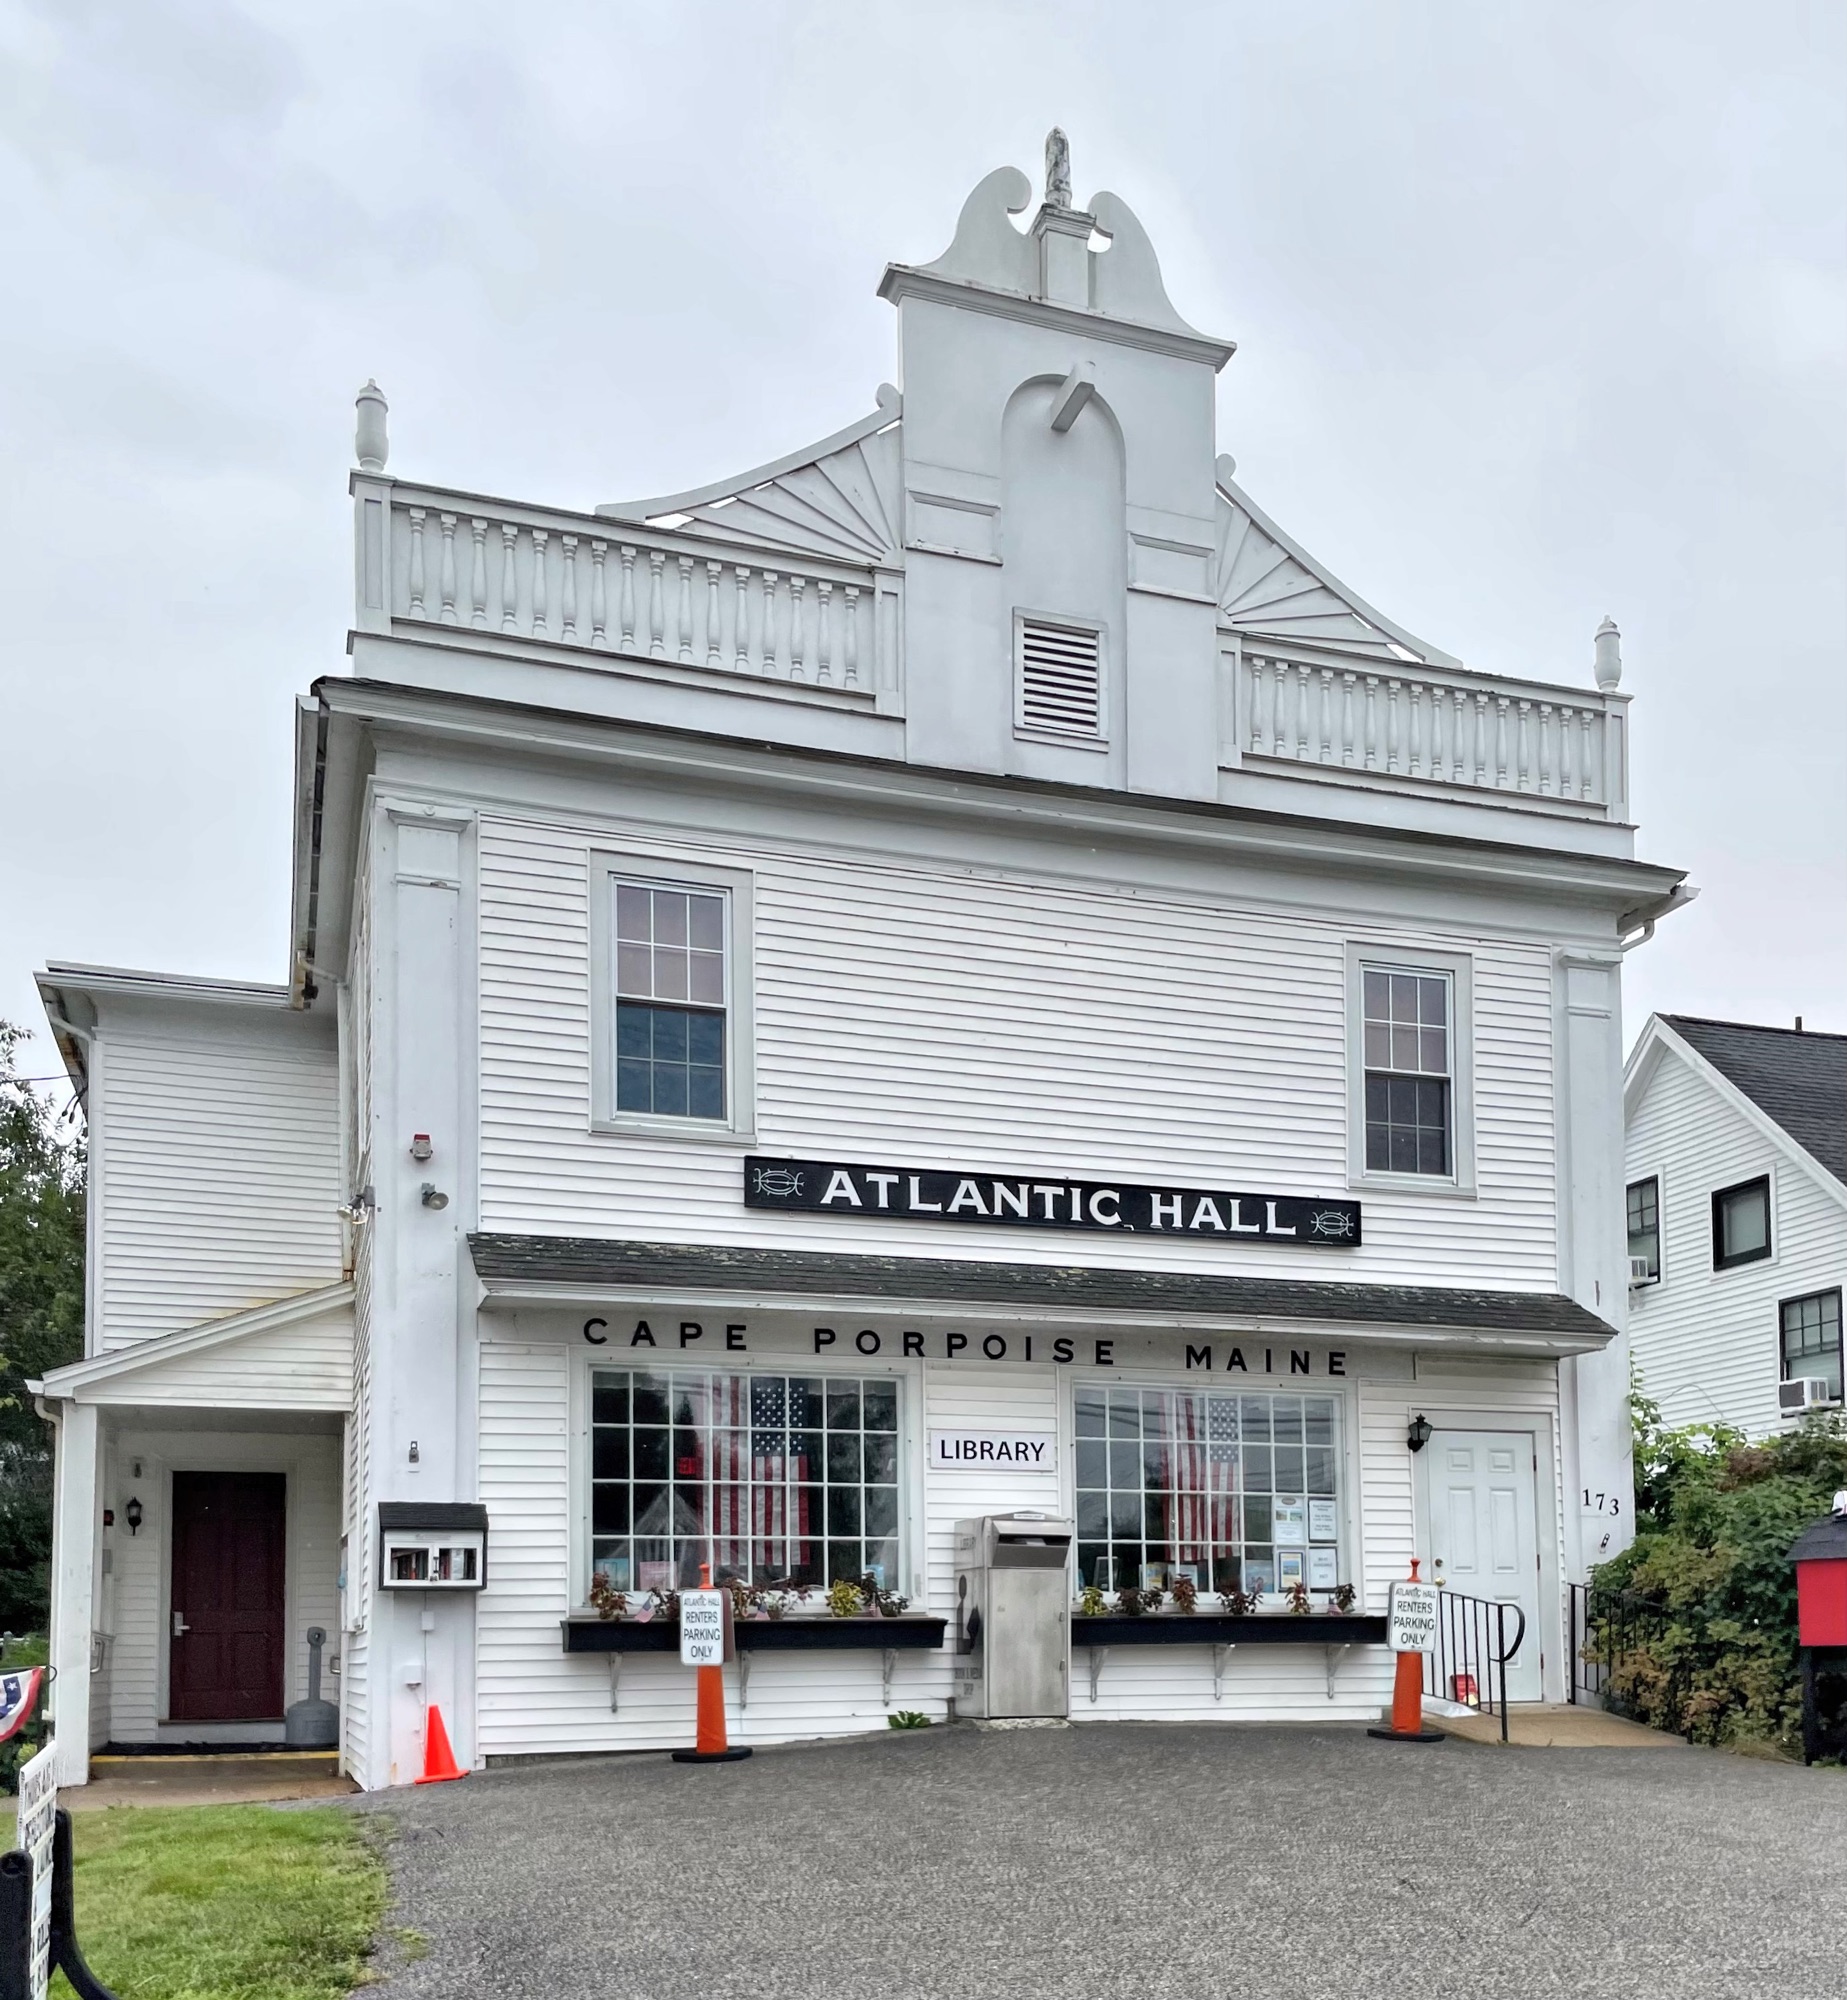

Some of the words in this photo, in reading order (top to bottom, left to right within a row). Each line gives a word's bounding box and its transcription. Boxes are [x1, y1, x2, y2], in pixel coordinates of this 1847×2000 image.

[820, 1170, 1123, 1227] ATLANTIC
[1150, 1193, 1297, 1236] HALL
[583, 1318, 748, 1351] CAPE
[814, 1327, 1115, 1366] PORPOISE
[1186, 1344, 1347, 1376] MAINE
[940, 1439, 1046, 1463] LIBRARY
[1582, 1488, 1620, 1517] 173
[1395, 1587, 1421, 1598] ATLANTIC
[1422, 1590, 1436, 1599] HALL
[683, 1597, 707, 1607] ATLANTIC
[708, 1597, 721, 1607] HALL
[1397, 1600, 1433, 1614] RENTERS
[685, 1611, 718, 1624] RENTERS
[1393, 1616, 1435, 1631] PARKING
[683, 1628, 721, 1641] PARKING
[1400, 1632, 1426, 1645] ONLY
[690, 1645, 713, 1658] ONLY
